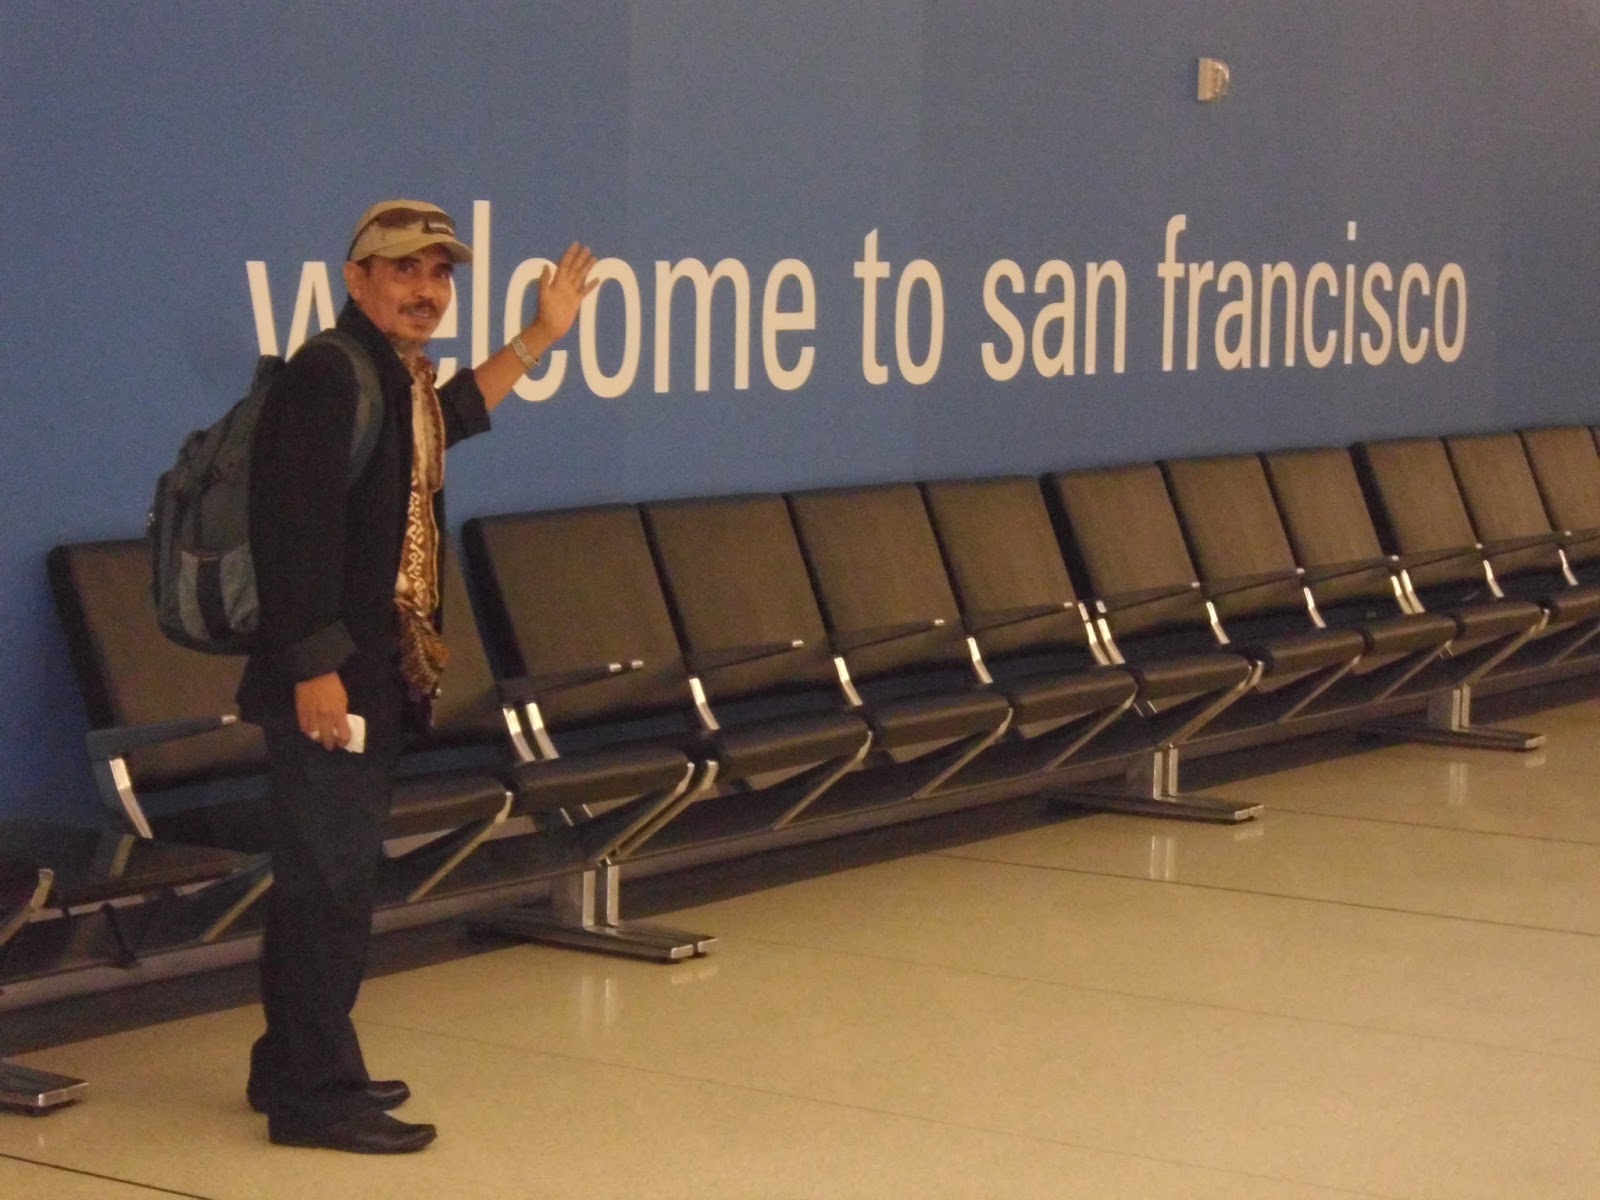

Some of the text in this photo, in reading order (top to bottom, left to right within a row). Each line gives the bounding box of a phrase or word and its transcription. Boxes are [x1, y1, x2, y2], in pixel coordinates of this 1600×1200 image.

[245, 199, 1468, 402] wlcome to san francisco
